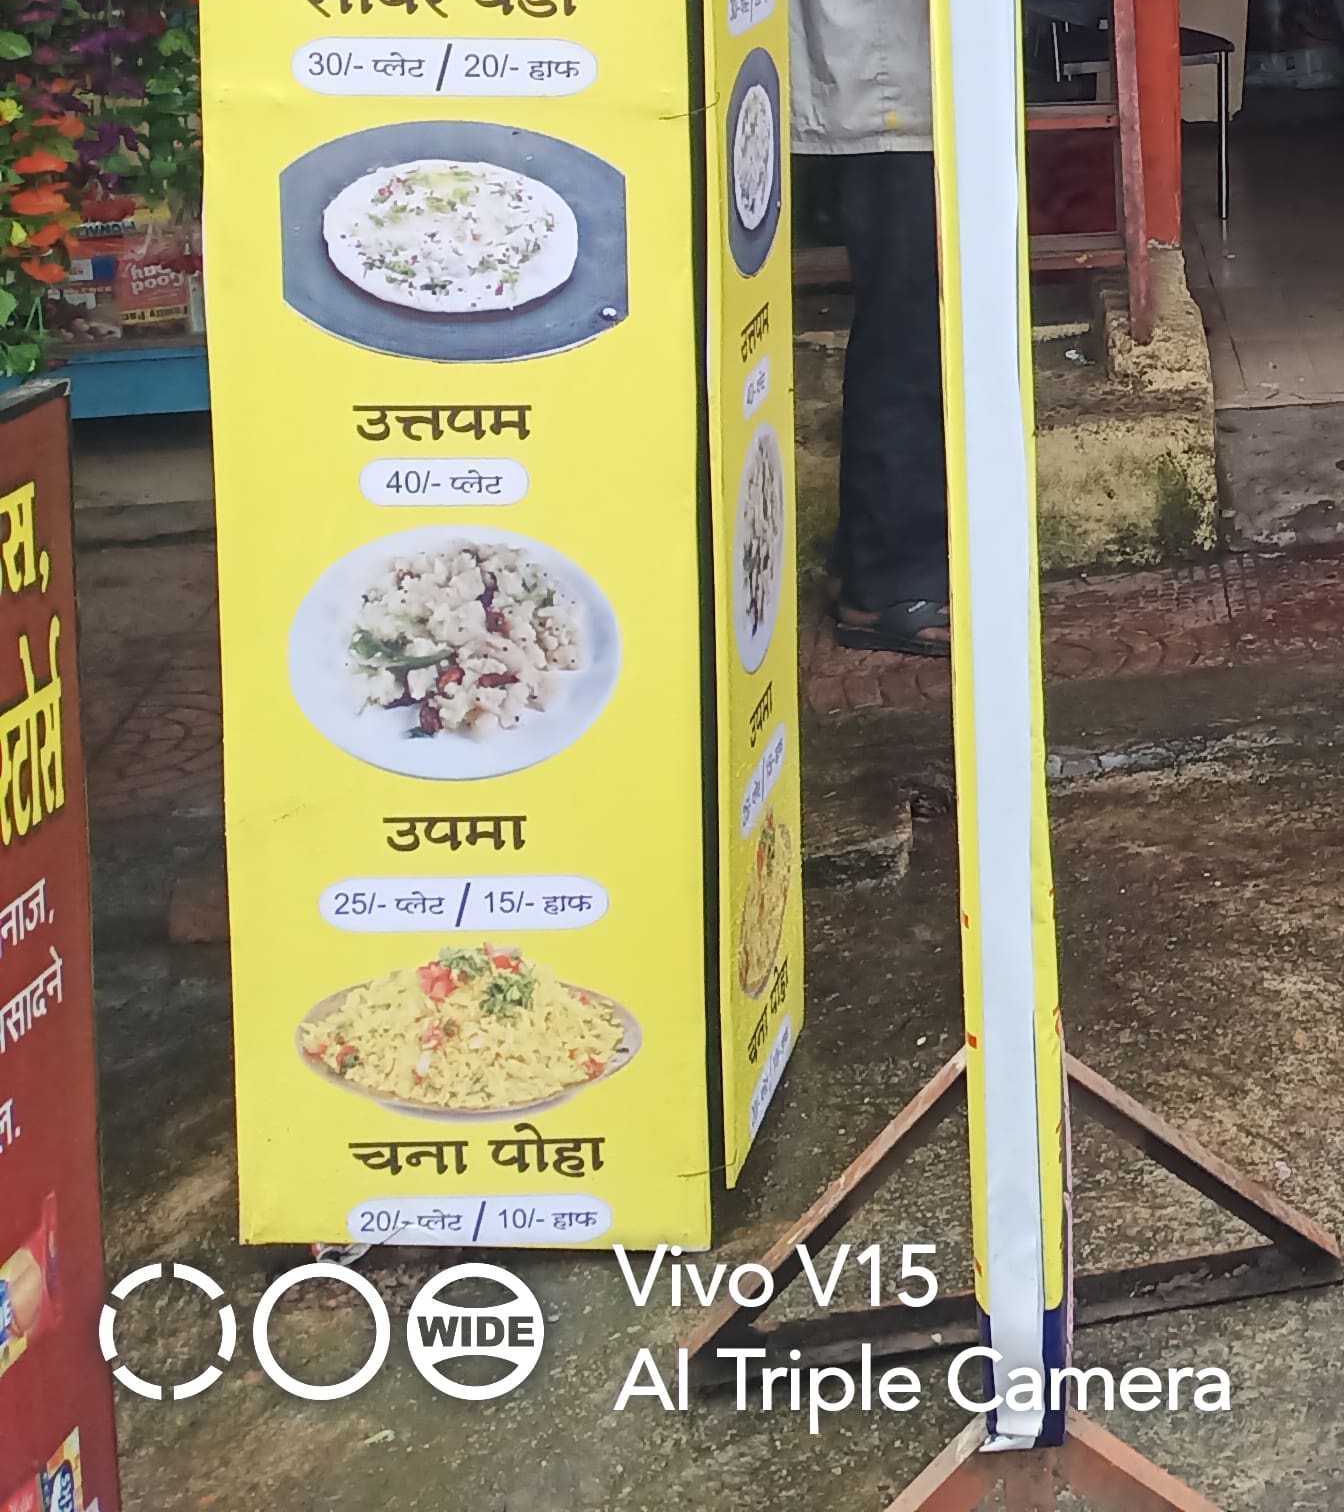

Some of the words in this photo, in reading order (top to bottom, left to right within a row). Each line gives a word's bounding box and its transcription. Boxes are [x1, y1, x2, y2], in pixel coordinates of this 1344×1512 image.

[307, 51, 364, 78] 30/-
[371, 50, 425, 80] प्लेट
[463, 53, 519, 80] 20/-
[527, 58, 581, 82] हाफ
[352, 402, 532, 443] उत्तपम
[385, 469, 441, 496] 40/-
[449, 468, 503, 496] प्लेट
[0, 481, 51, 594] स,
[382, 814, 528, 853] उपमा
[0, 877, 55, 948] नाज,
[333, 891, 387, 917] 25/-
[394, 891, 446, 917] प्लेट
[483, 890, 535, 915] 15/-
[542, 894, 592, 916] हाफ
[348, 1138, 468, 1176] चना
[488, 1122, 605, 1178] पोहा
[416, 1209, 463, 1232] प्लेट
[498, 1208, 545, 1230] 10/-
[552, 1209, 598, 1230] हाफ
